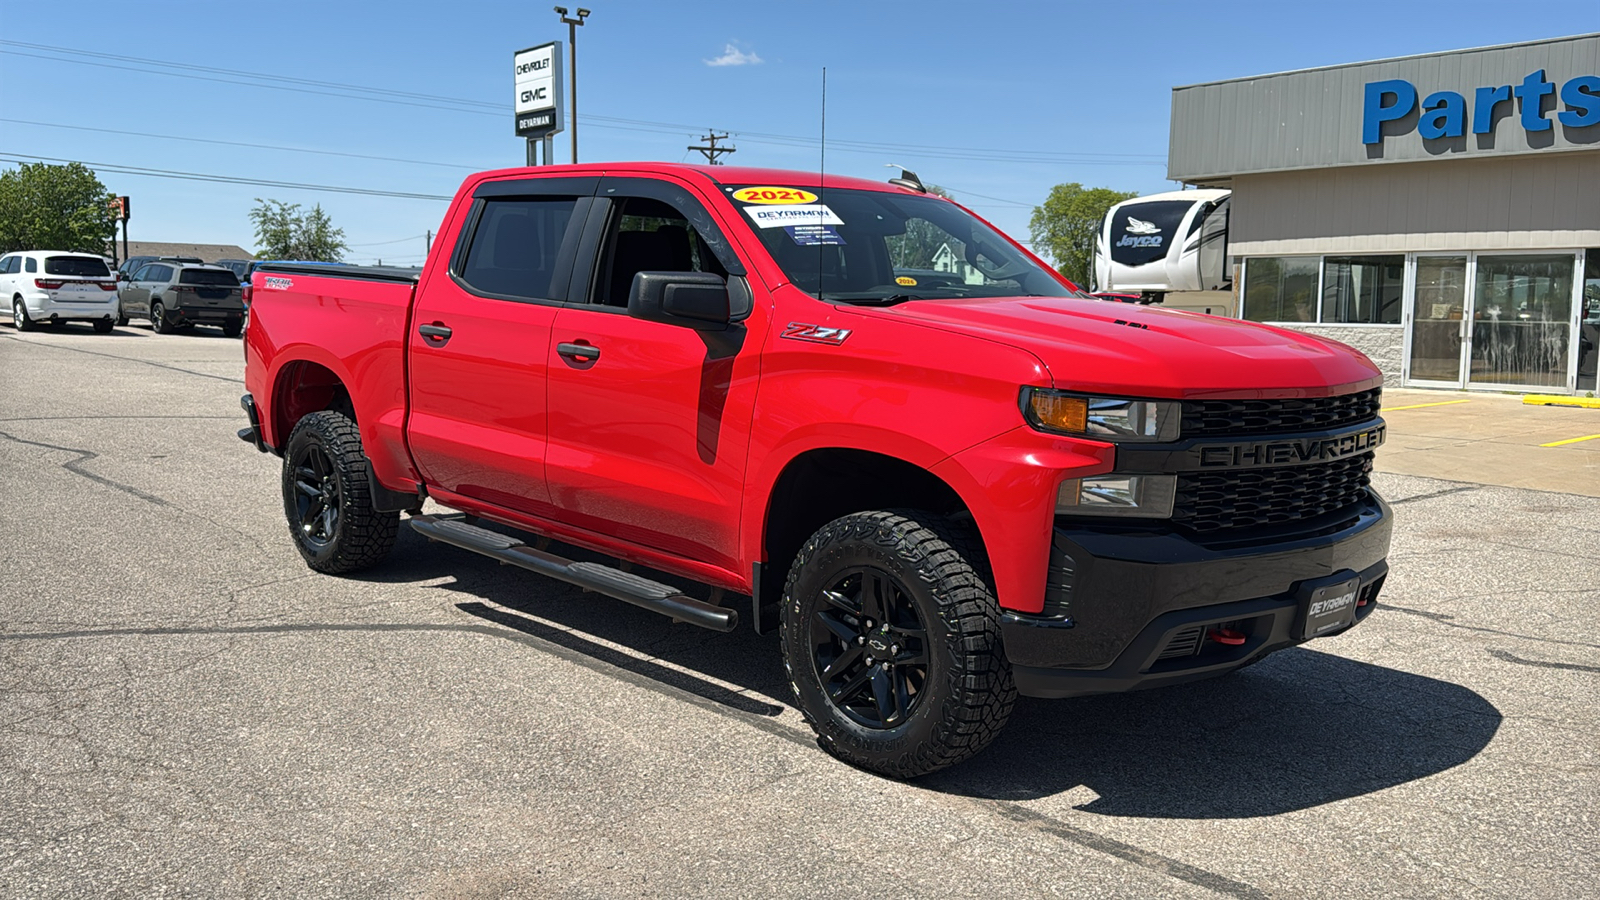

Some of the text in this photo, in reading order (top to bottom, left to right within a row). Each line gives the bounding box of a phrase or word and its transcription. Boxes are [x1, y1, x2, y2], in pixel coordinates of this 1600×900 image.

[516, 58, 550, 75] CHEVROLET
[521, 87, 546, 103] GMC
[1362, 69, 1600, 144] Parts
[519, 115, 550, 129] DEYARMAN
[744, 190, 806, 200] 2021
[757, 210, 830, 218] DEYARMAN
[1116, 234, 1162, 248] Jayco
[780, 321, 853, 346] Z71
[1200, 426, 1386, 467] CHEVROLET
[1309, 591, 1356, 616] DEYARMAN
